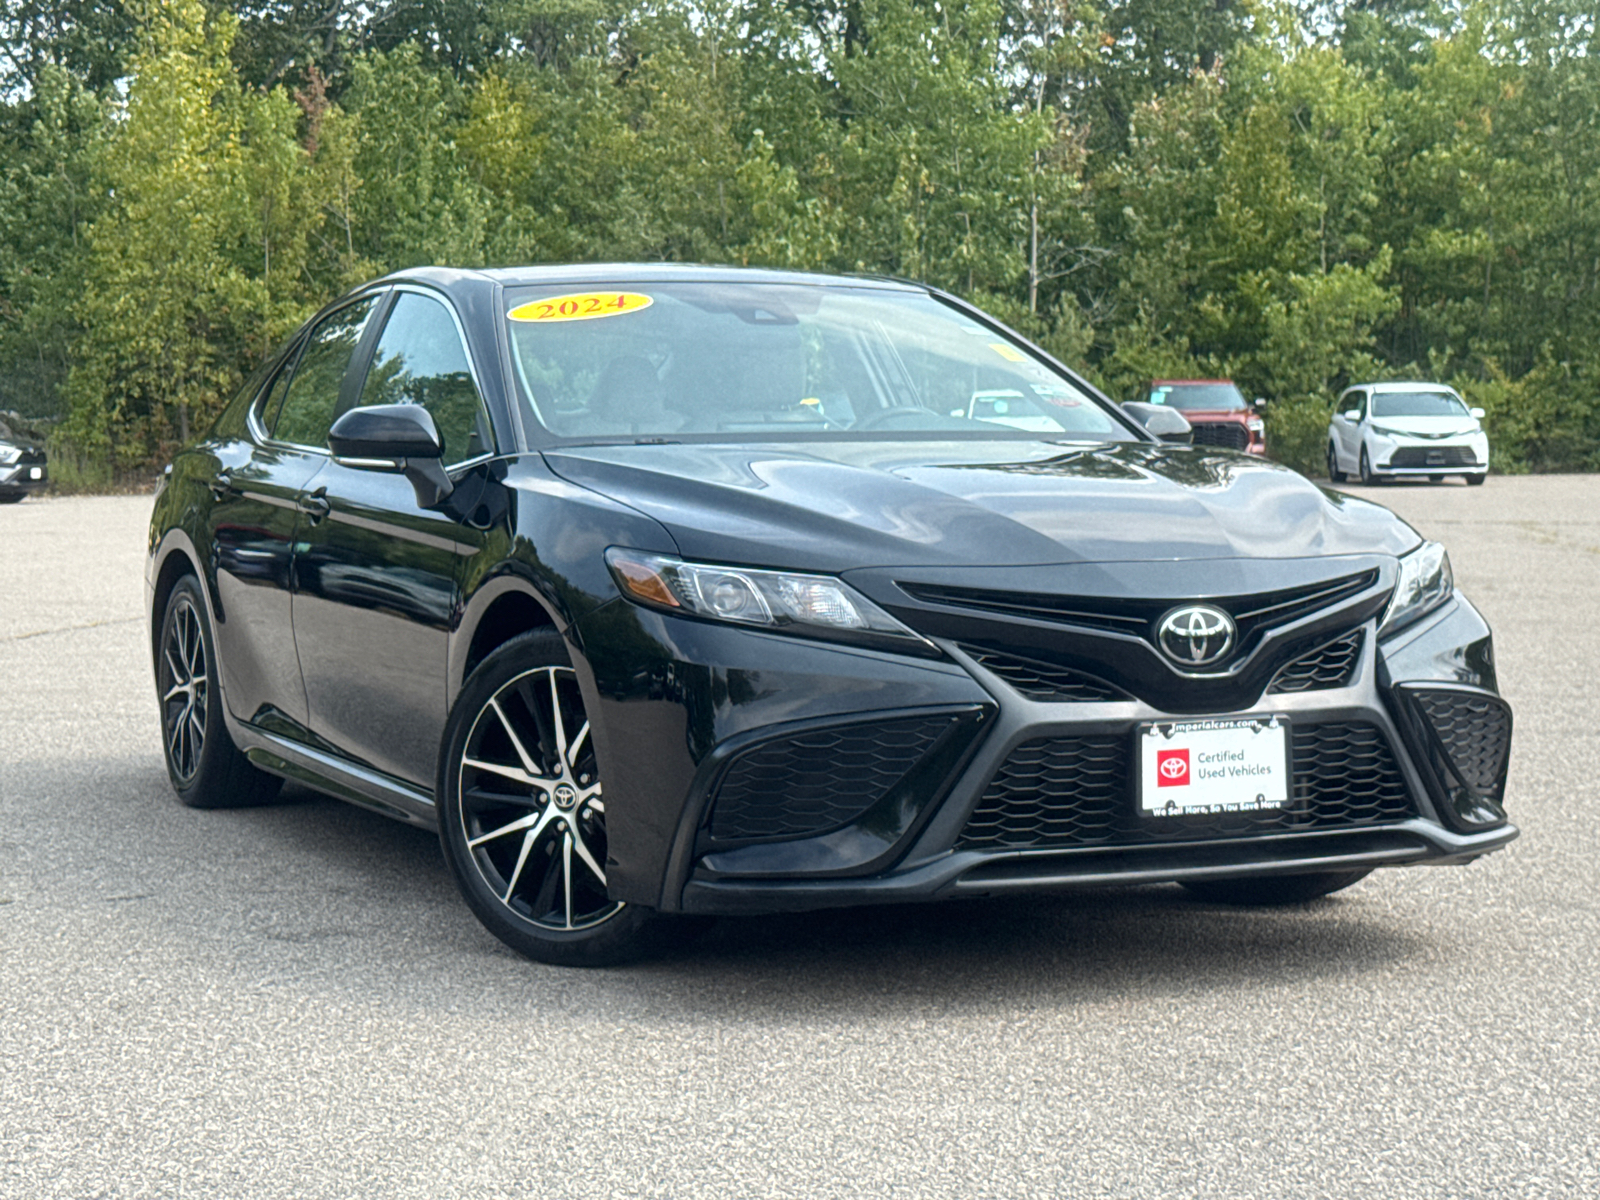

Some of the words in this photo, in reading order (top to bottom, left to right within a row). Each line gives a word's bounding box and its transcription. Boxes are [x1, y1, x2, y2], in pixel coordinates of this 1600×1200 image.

[537, 294, 627, 320] 2024
[1197, 749, 1245, 764] Certified
[1198, 767, 1225, 779] Used
[1228, 763, 1272, 777] Vehicles
[1152, 807, 1167, 817] We
[1168, 806, 1183, 816] Sell
[1210, 803, 1220, 813] So
[1222, 802, 1238, 812] You
[1240, 801, 1259, 811] Save
[1260, 800, 1281, 809] More
